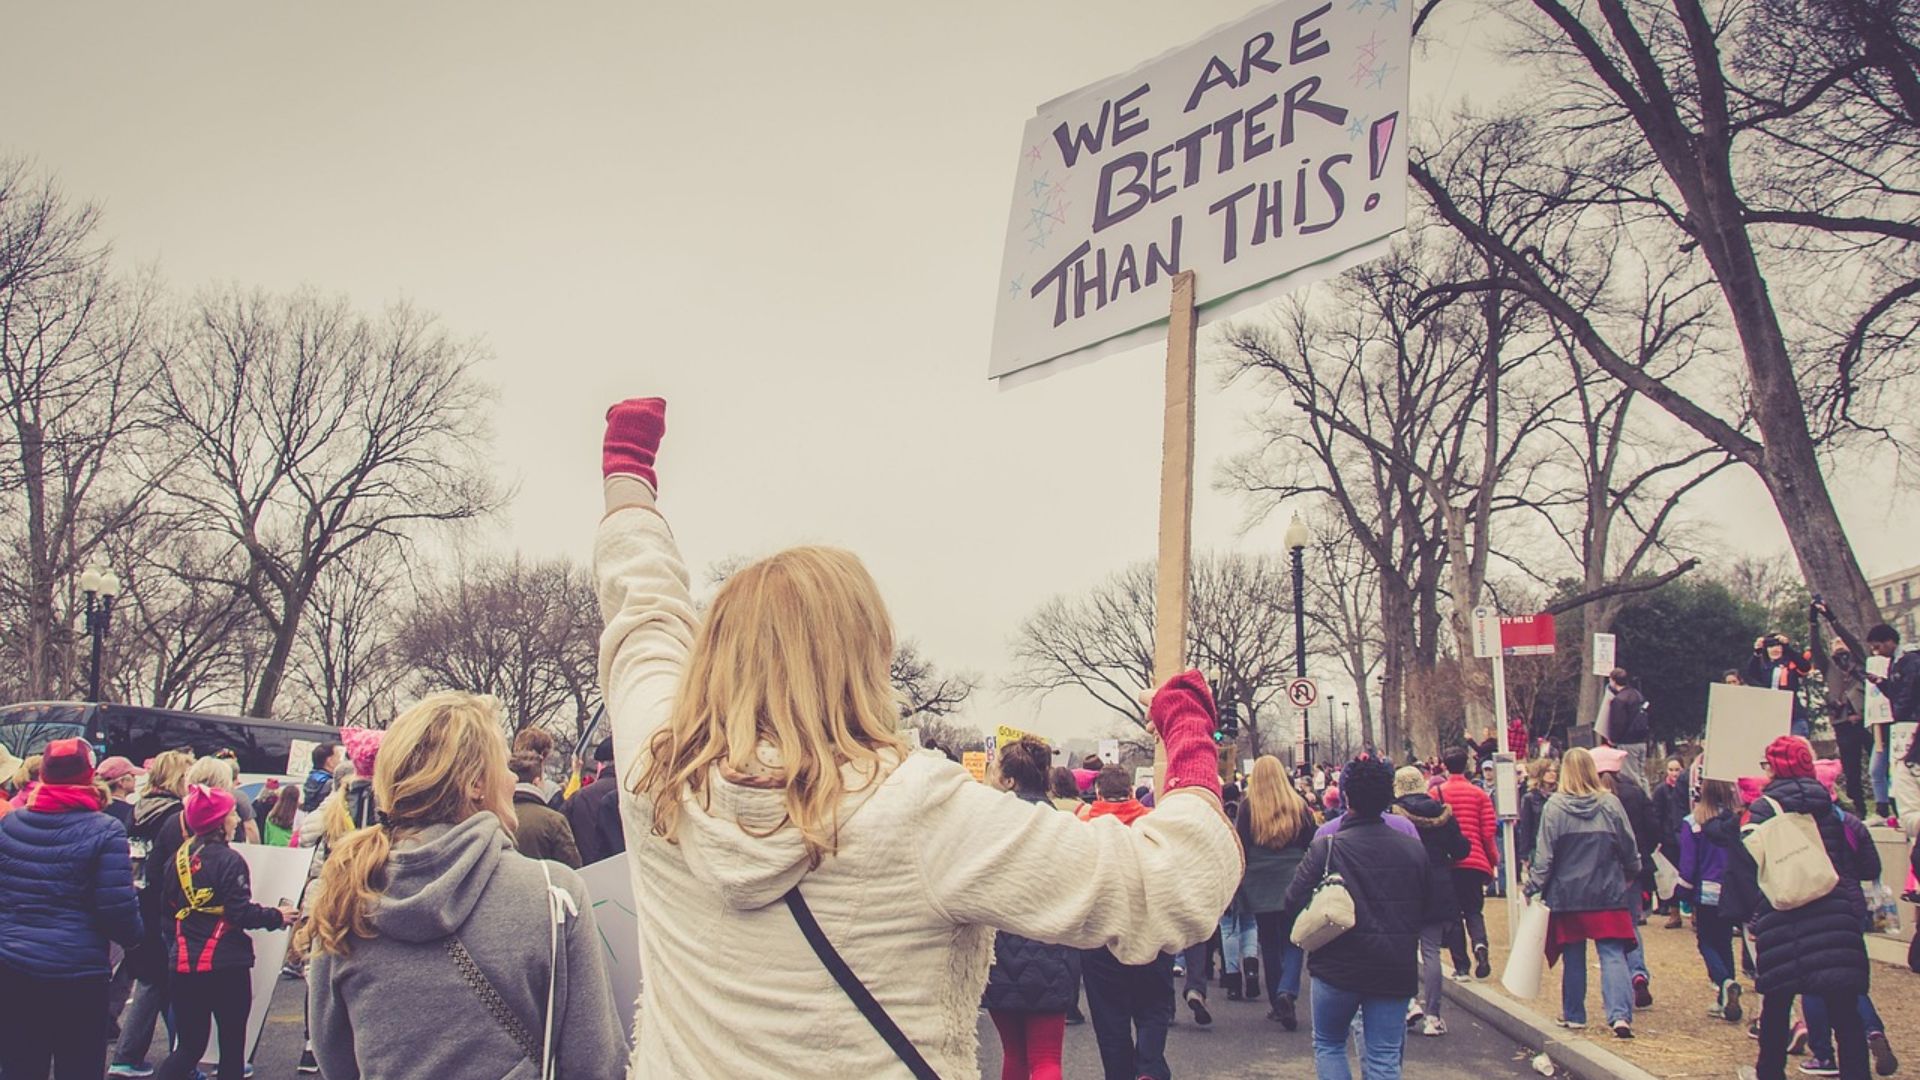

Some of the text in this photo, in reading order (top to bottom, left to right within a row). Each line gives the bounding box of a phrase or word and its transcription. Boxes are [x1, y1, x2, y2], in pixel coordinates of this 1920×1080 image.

[1053, 3, 1332, 168] WE ARE
[1093, 76, 1348, 233] BETTER
[1031, 216, 1182, 328] THAN
